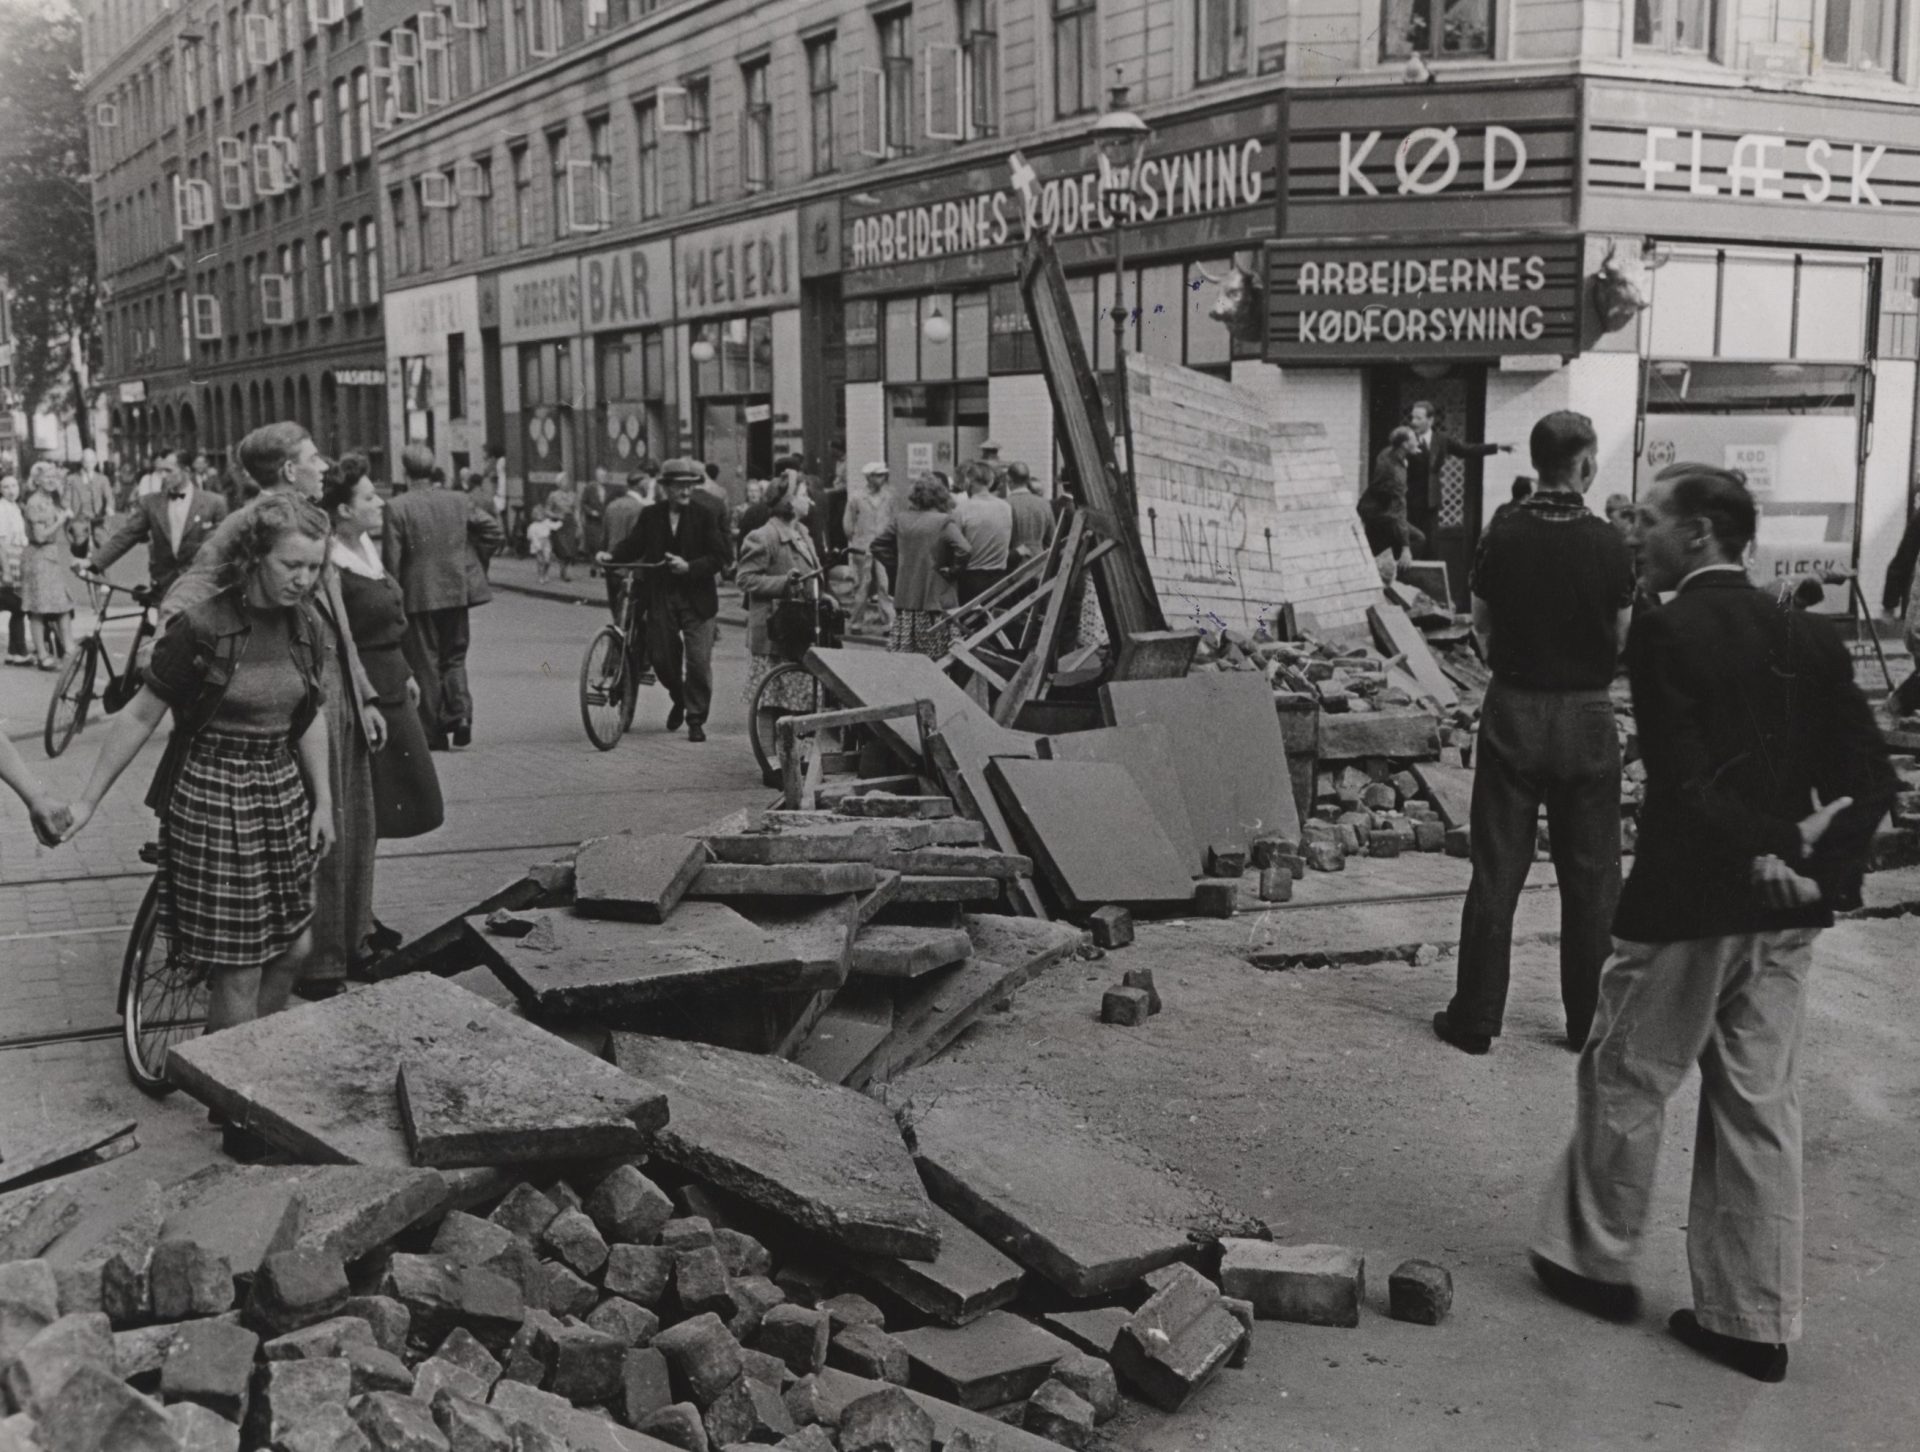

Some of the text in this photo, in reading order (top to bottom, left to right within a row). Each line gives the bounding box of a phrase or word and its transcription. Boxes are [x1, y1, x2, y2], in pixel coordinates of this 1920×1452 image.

[1339, 125, 1527, 197] KØD
[1639, 127, 1886, 207] FLÆSK
[588, 251, 650, 323] BAR
[1299, 304, 1544, 342] KØDFORSYNING
